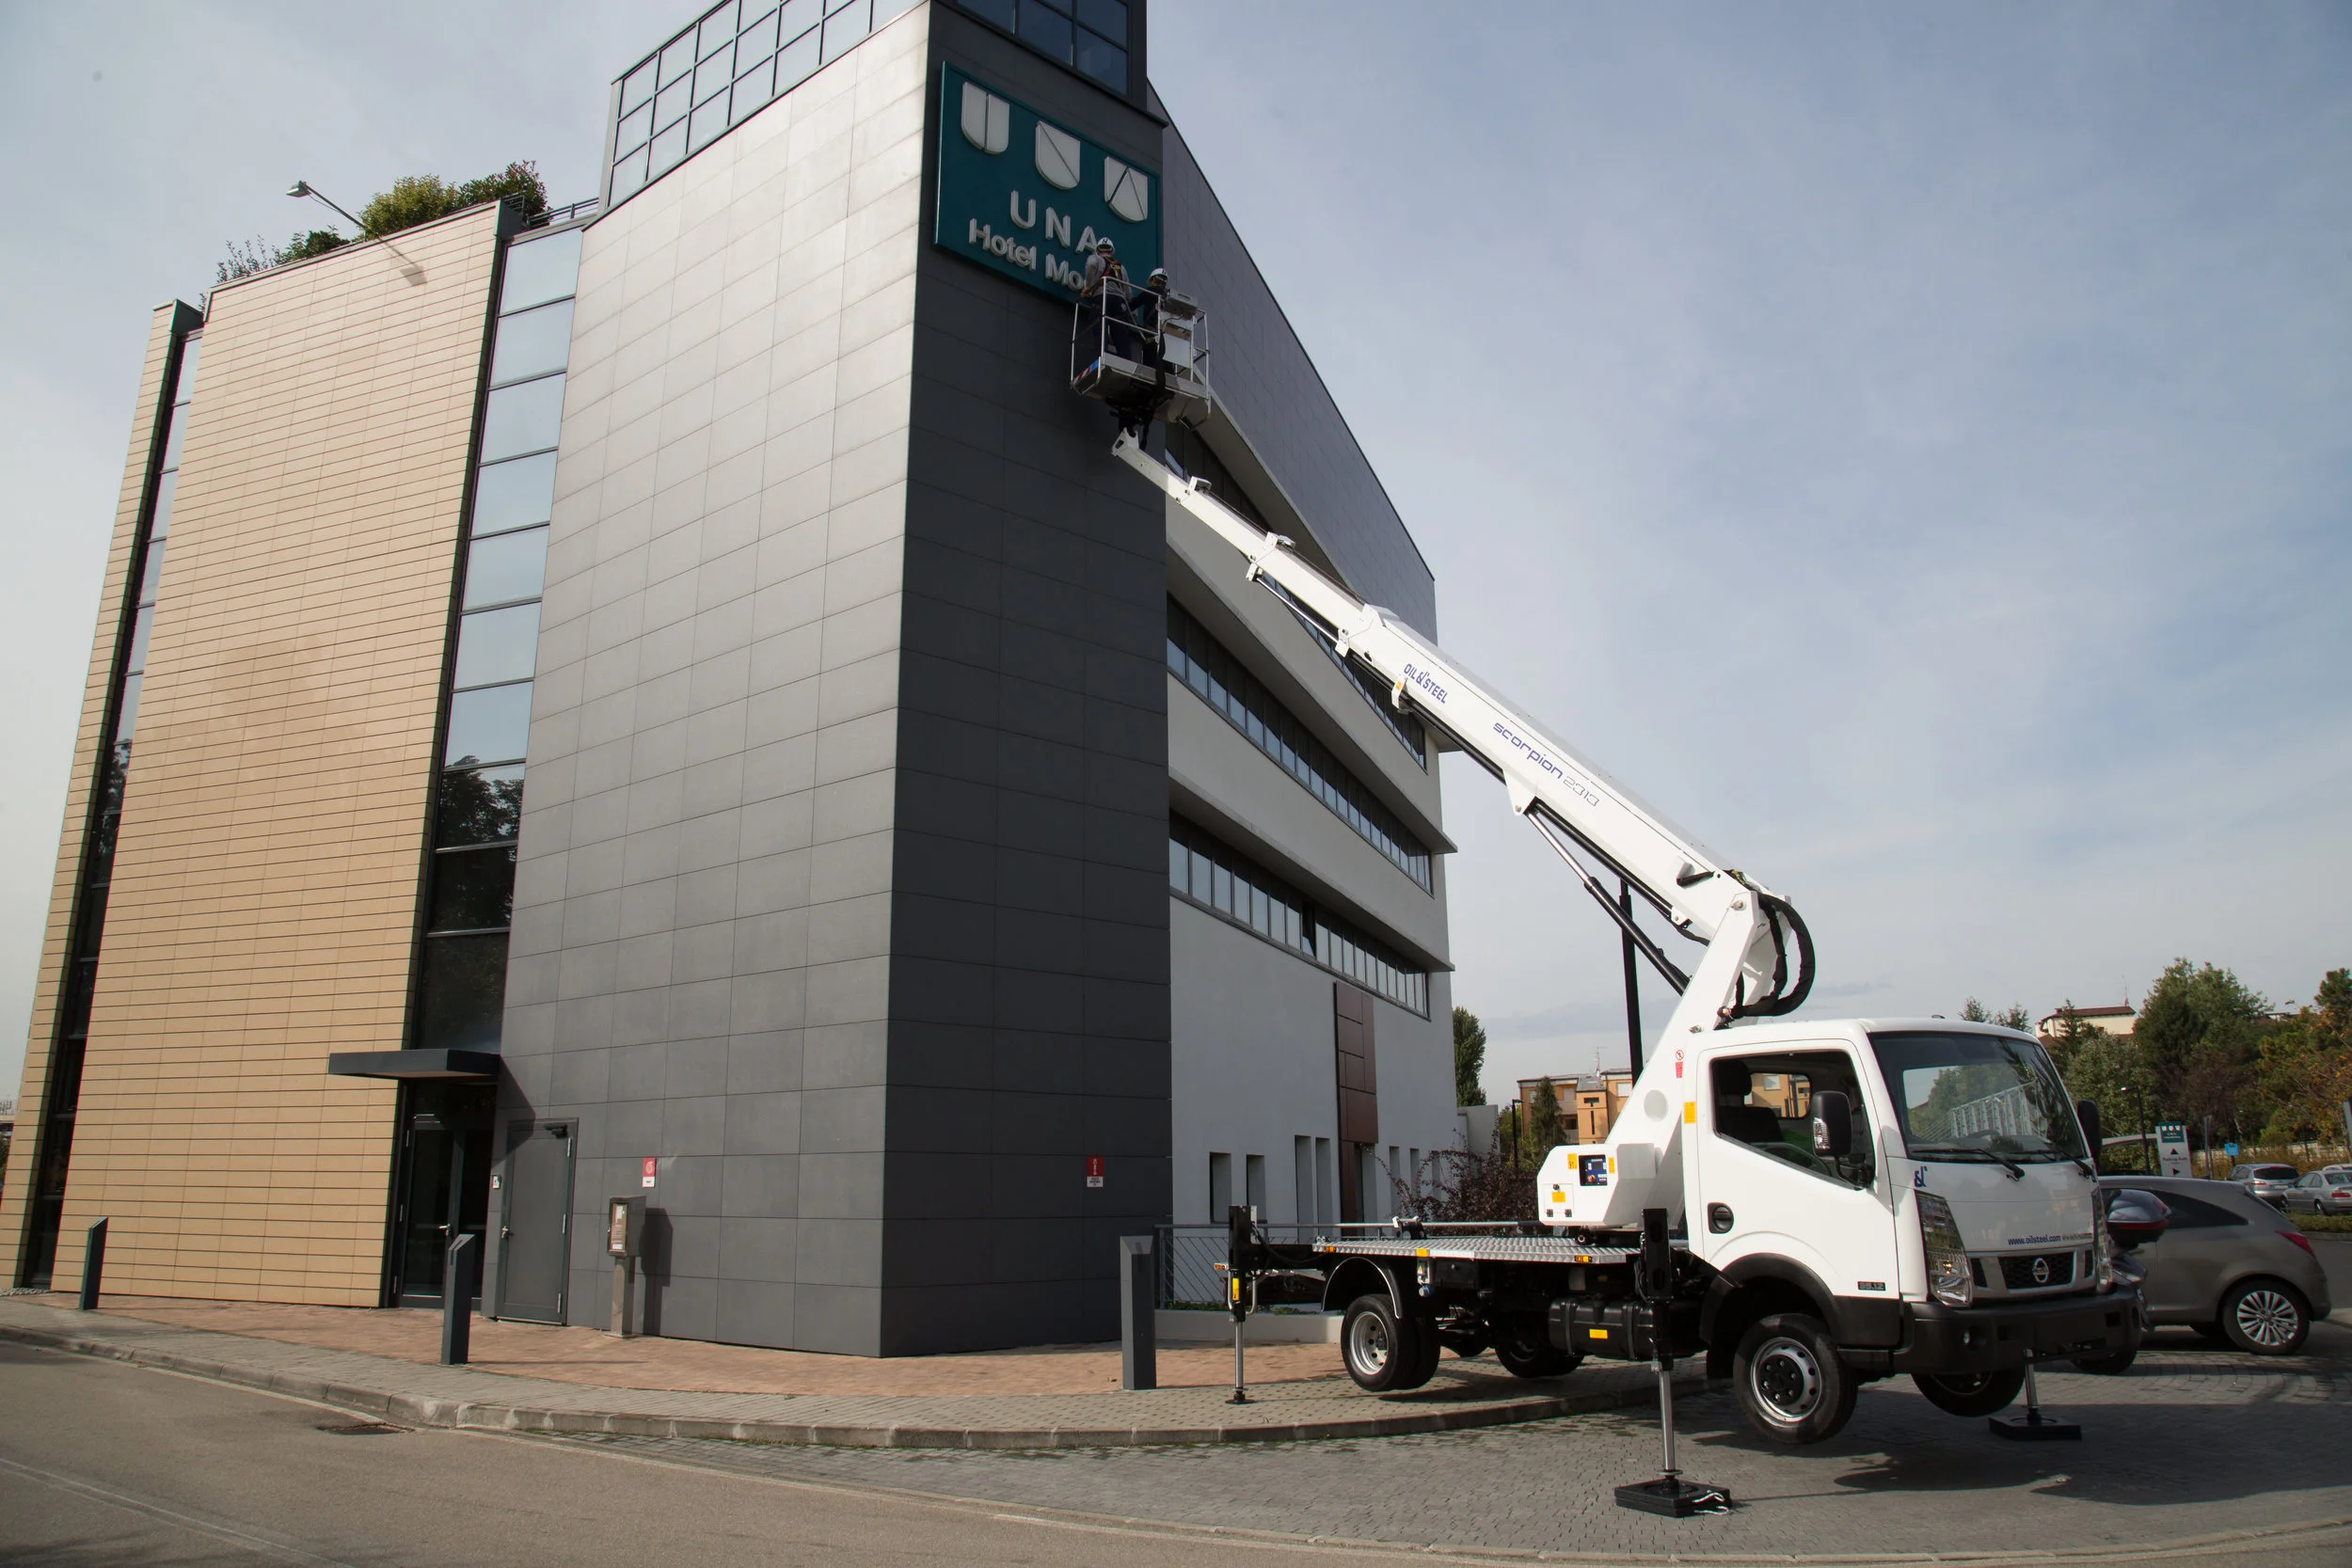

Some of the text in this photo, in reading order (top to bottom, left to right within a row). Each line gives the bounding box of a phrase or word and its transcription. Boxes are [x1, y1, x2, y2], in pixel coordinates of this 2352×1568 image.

[968, 217, 1038, 271] Hotel
[1009, 189, 1098, 255] UNA
[1492, 721, 1565, 780] scorpion
